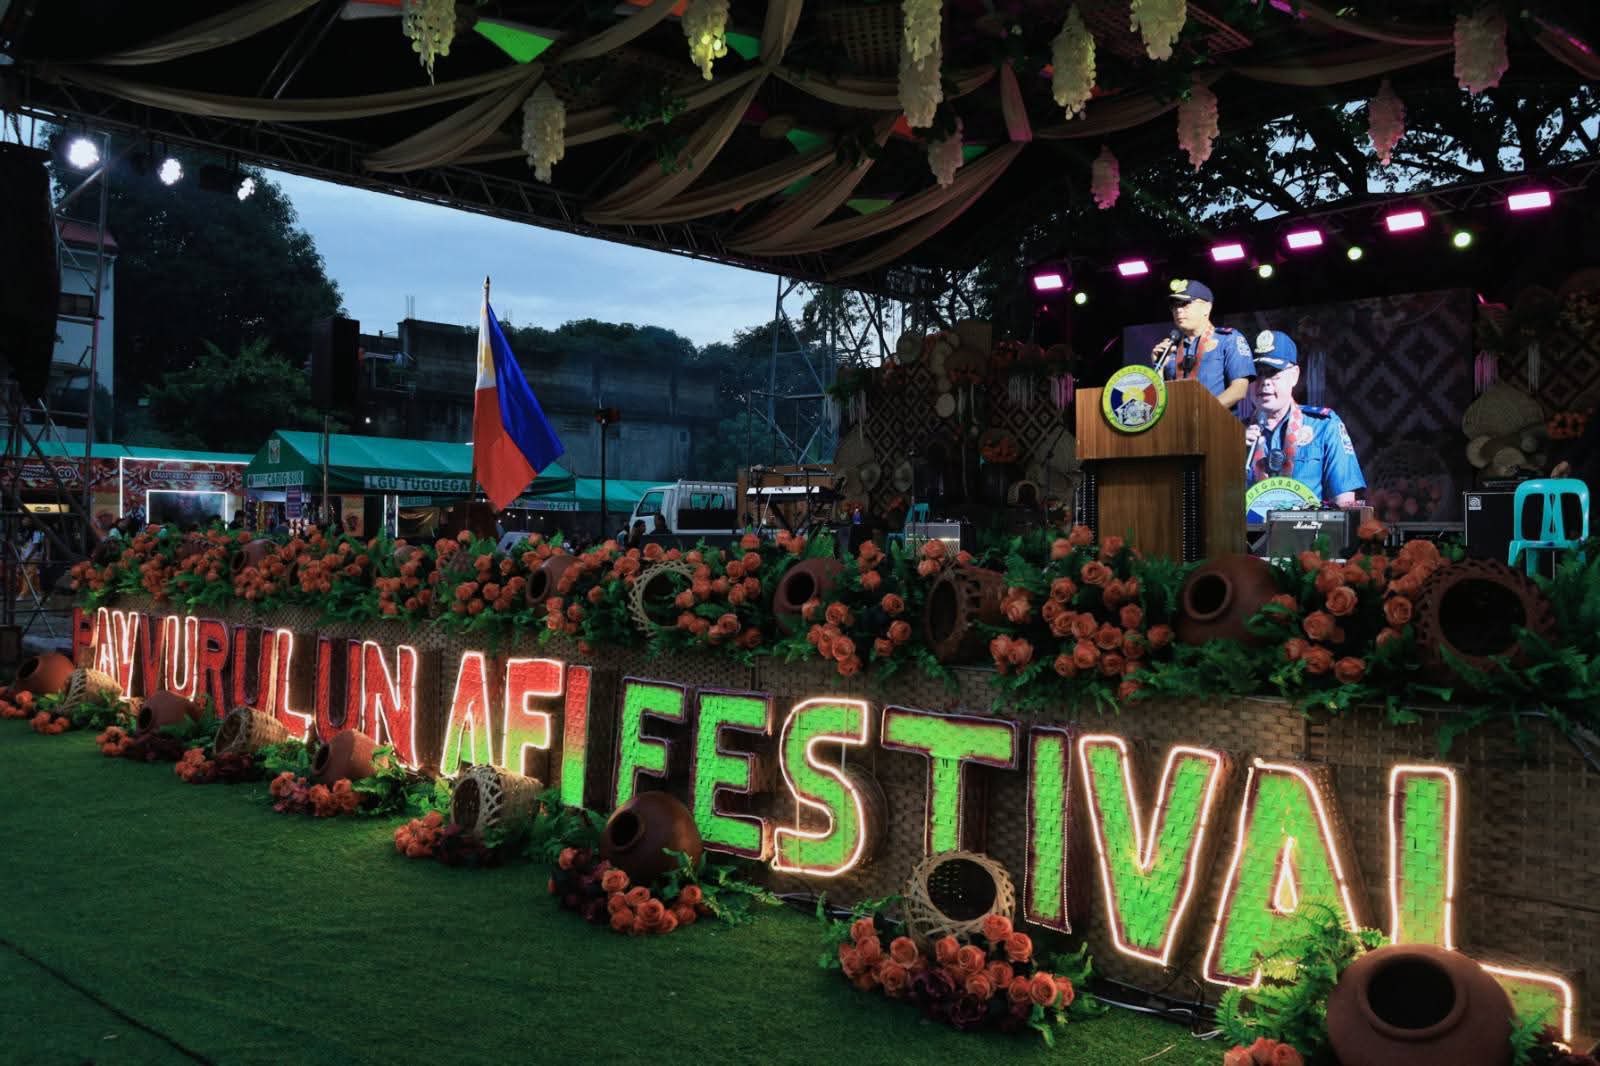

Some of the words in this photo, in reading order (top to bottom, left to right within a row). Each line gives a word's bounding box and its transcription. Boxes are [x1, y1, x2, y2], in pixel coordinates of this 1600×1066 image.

[369, 475, 397, 489] LGU
[401, 478, 486, 492] TUGUEGA
[439, 650, 592, 809] AFI
[609, 673, 1576, 1054] FESTIVAL
